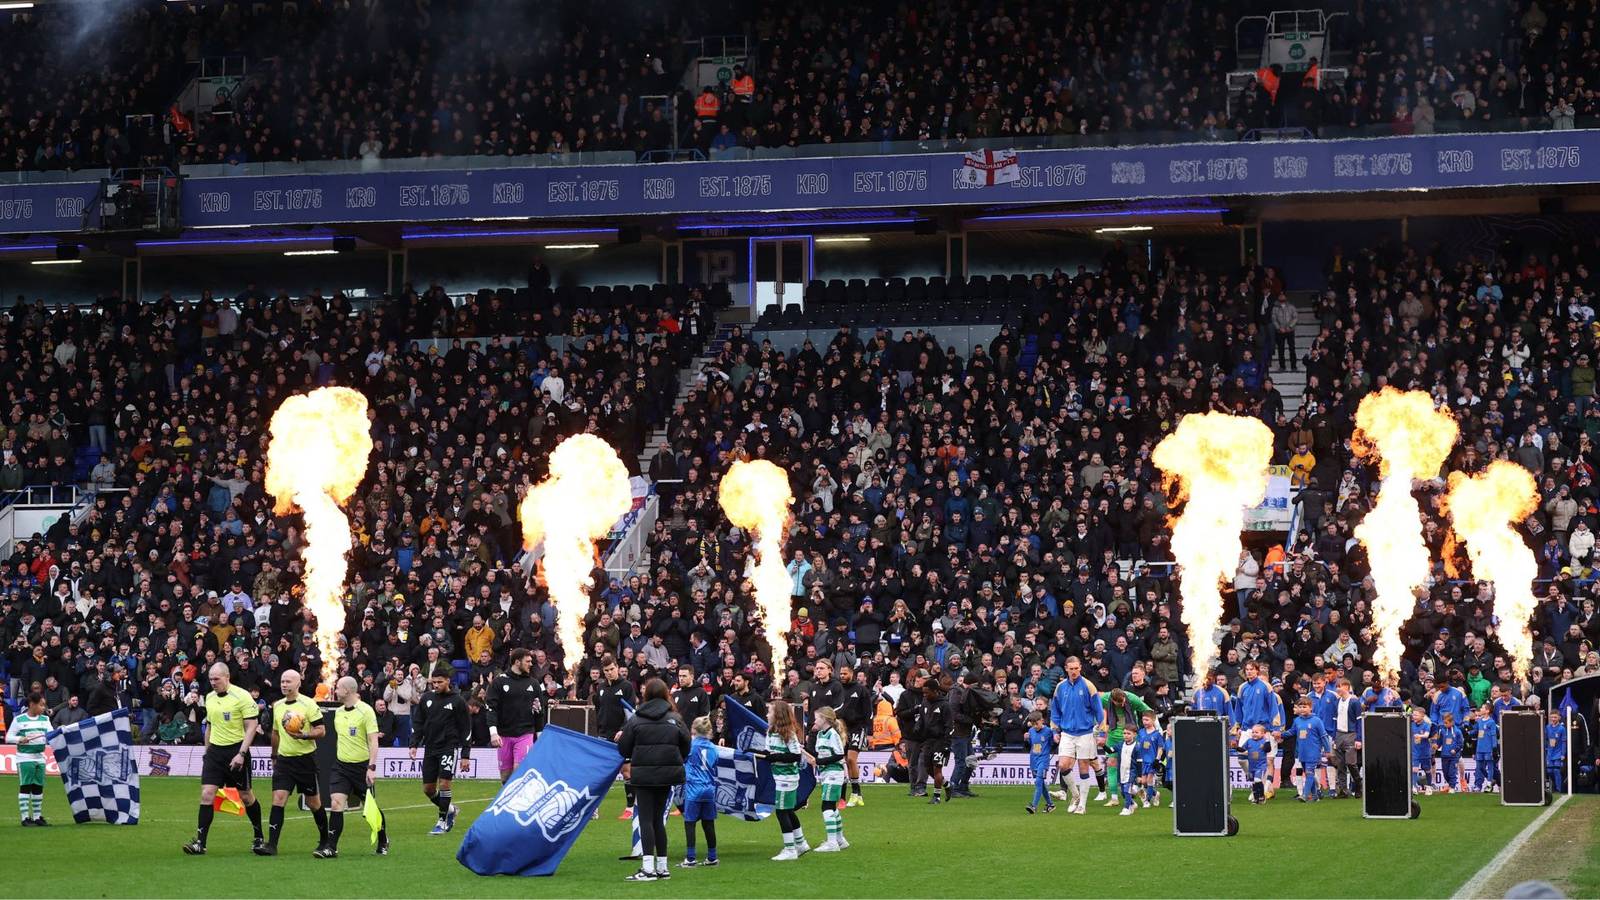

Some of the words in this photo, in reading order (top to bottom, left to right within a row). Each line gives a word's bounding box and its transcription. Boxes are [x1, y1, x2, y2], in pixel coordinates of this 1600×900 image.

[56, 197, 85, 217] KRO
[201, 192, 230, 212] KRO
[347, 186, 376, 208] KRO
[493, 182, 524, 203] KRO
[643, 177, 675, 200] KRO
[796, 172, 829, 195] KRO
[1111, 161, 1145, 184] KRO
[1273, 155, 1308, 178] KRO
[1438, 150, 1474, 173] KRO
[441, 755, 454, 766] 24
[933, 752, 943, 762] 29
[390, 761, 407, 772] ST.
